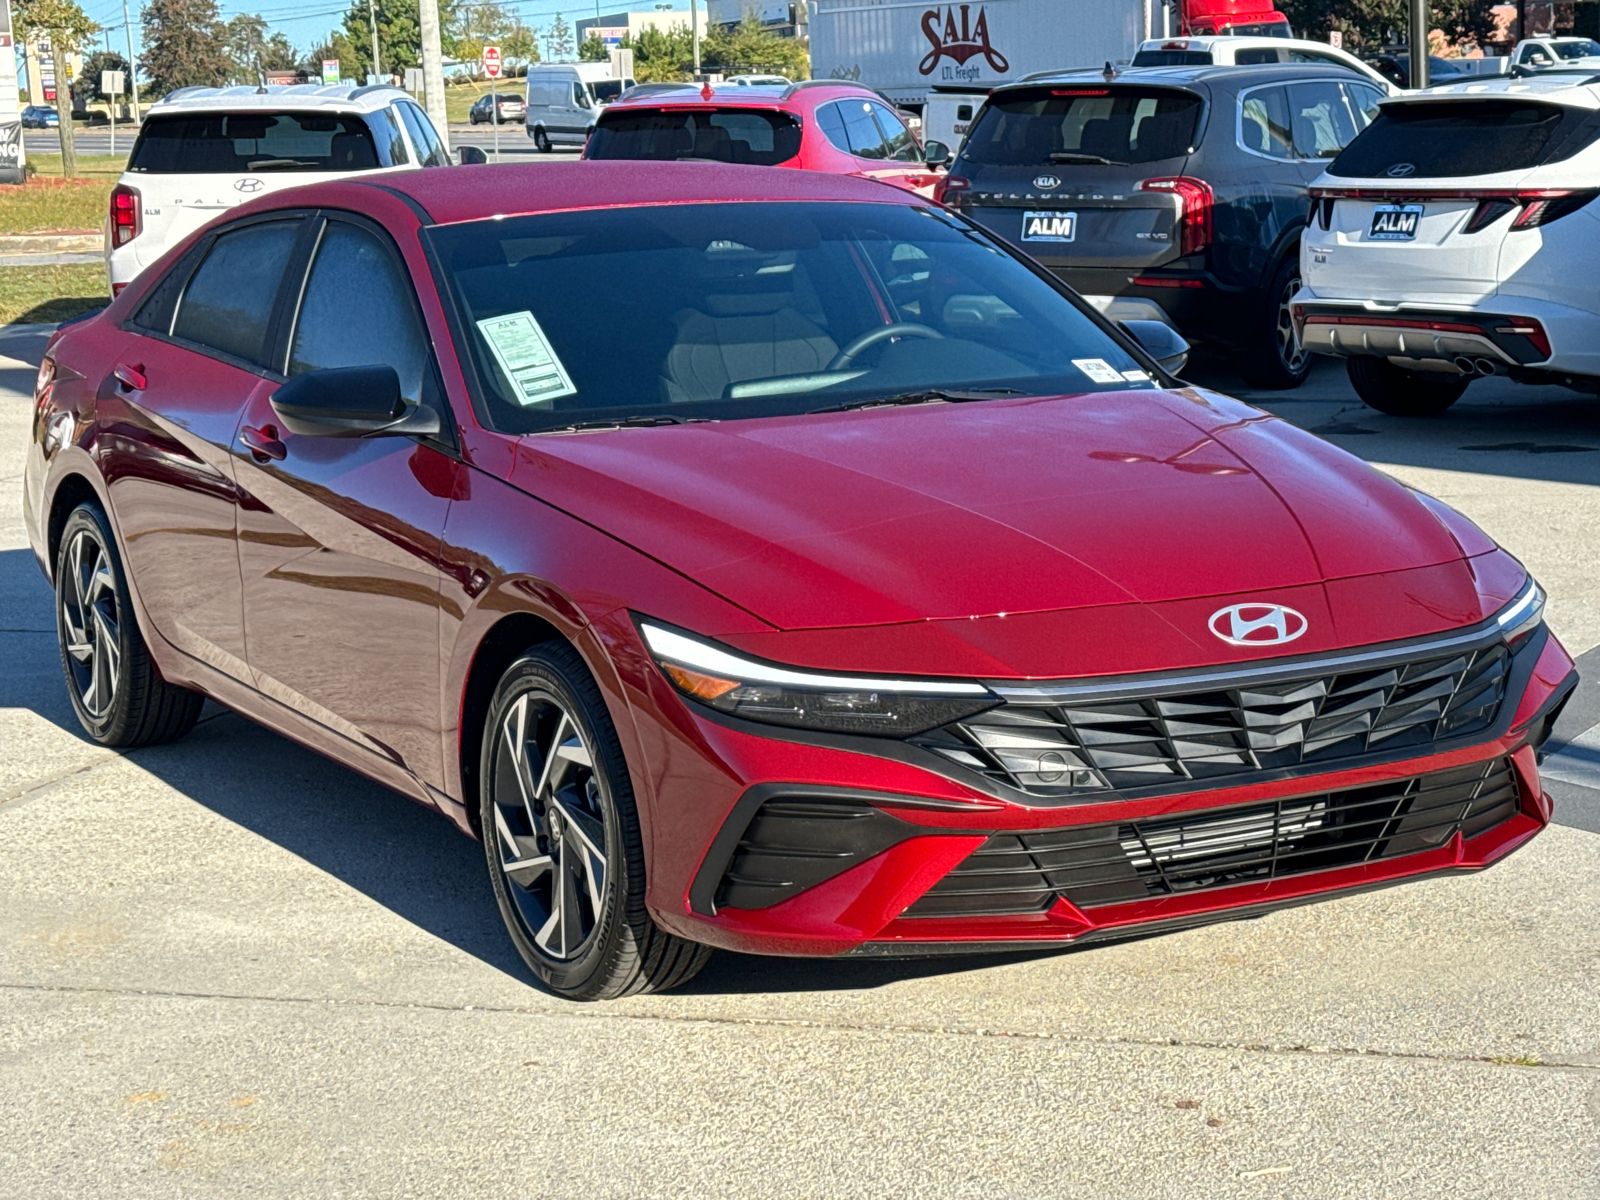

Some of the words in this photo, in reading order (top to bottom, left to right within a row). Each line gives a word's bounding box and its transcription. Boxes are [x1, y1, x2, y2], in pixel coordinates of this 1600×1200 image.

[919, 4, 1009, 75] SAIA
[941, 66, 954, 80] LTL
[955, 64, 981, 82] Freight
[1037, 177, 1056, 186] KIA
[144, 208, 161, 216] ALM
[1028, 217, 1071, 236] ALM
[1374, 213, 1416, 231] ALM
